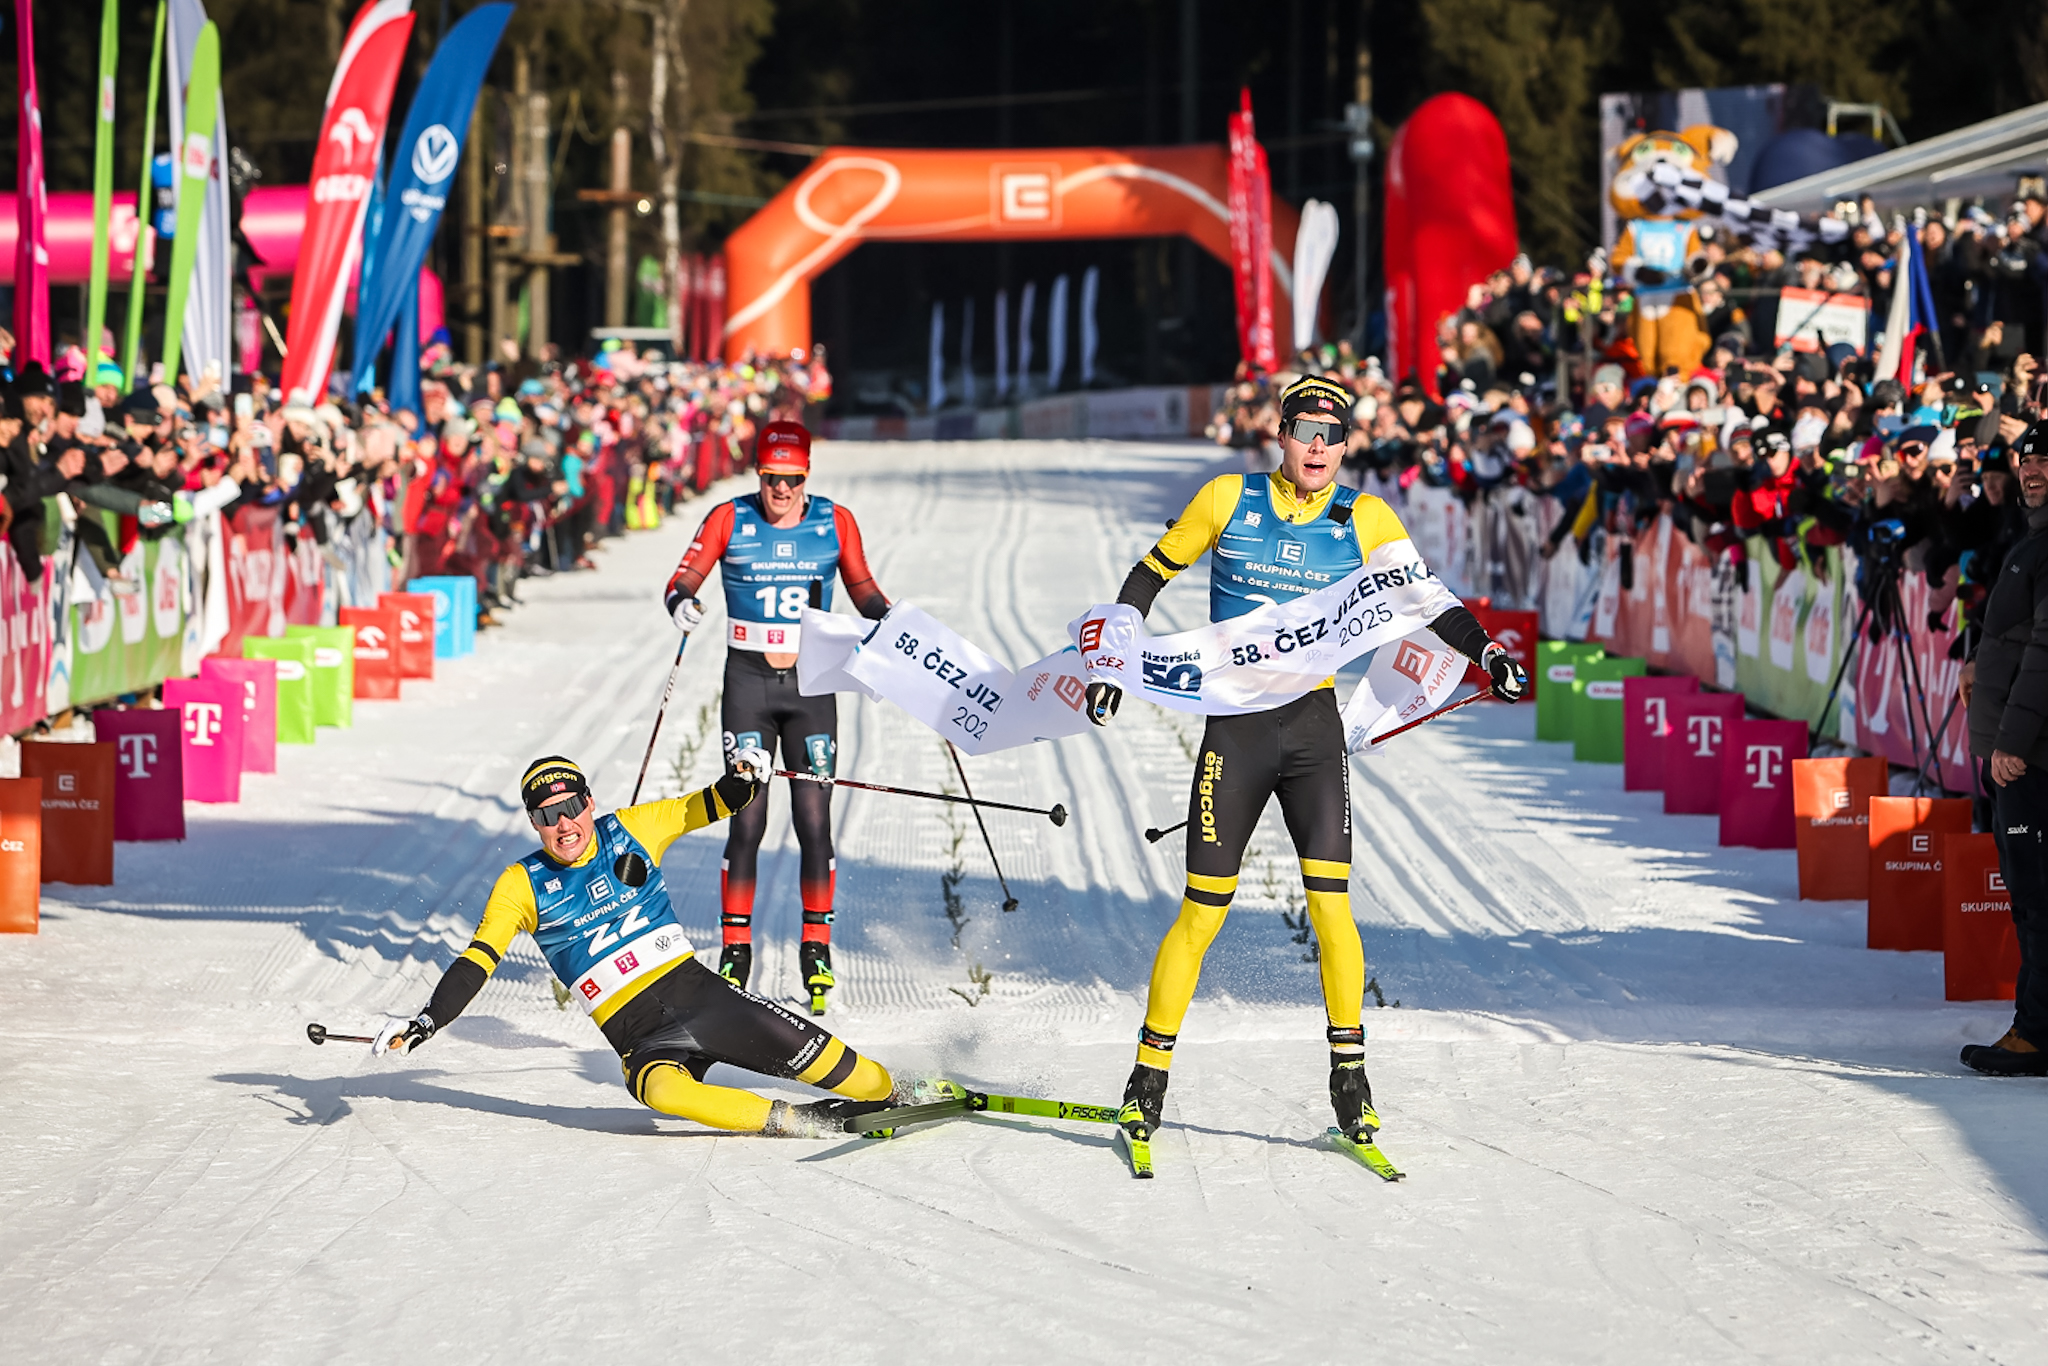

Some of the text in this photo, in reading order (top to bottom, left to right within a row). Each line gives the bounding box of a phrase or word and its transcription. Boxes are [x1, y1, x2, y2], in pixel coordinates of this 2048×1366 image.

[751, 560, 818, 570] SKUPINA ČEZ
[1245, 562, 1331, 583] SKUPINA ČEZ
[1248, 575, 1270, 588] ČEZ
[755, 585, 810, 620] 18
[1338, 602, 1393, 647] 2025
[1231, 644, 1270, 666] 58.
[1274, 618, 1329, 654] ČEZ
[1096, 654, 1125, 671] ČEZ
[1141, 649, 1201, 664] Jizerská
[895, 631, 1004, 715] 58. ČEZ JIZ
[1142, 660, 1203, 693] 50
[1688, 716, 1722, 757] T
[119, 733, 158, 779] T
[1746, 745, 1783, 788] T
[530, 771, 578, 791] engcon
[41, 799, 100, 810] KUPINA ČEZ
[1199, 750, 1218, 843] engcon
[1811, 814, 1869, 827] SKUPINA ČE
[1, 838, 25, 852] ČEZ
[1885, 861, 1932, 871] SKUPINA
[573, 901, 620, 927] SKUPINA
[620, 888, 639, 904] ČEZ
[1961, 901, 2012, 912] SKUPINA
[1071, 1106, 1116, 1121] FISCHER
